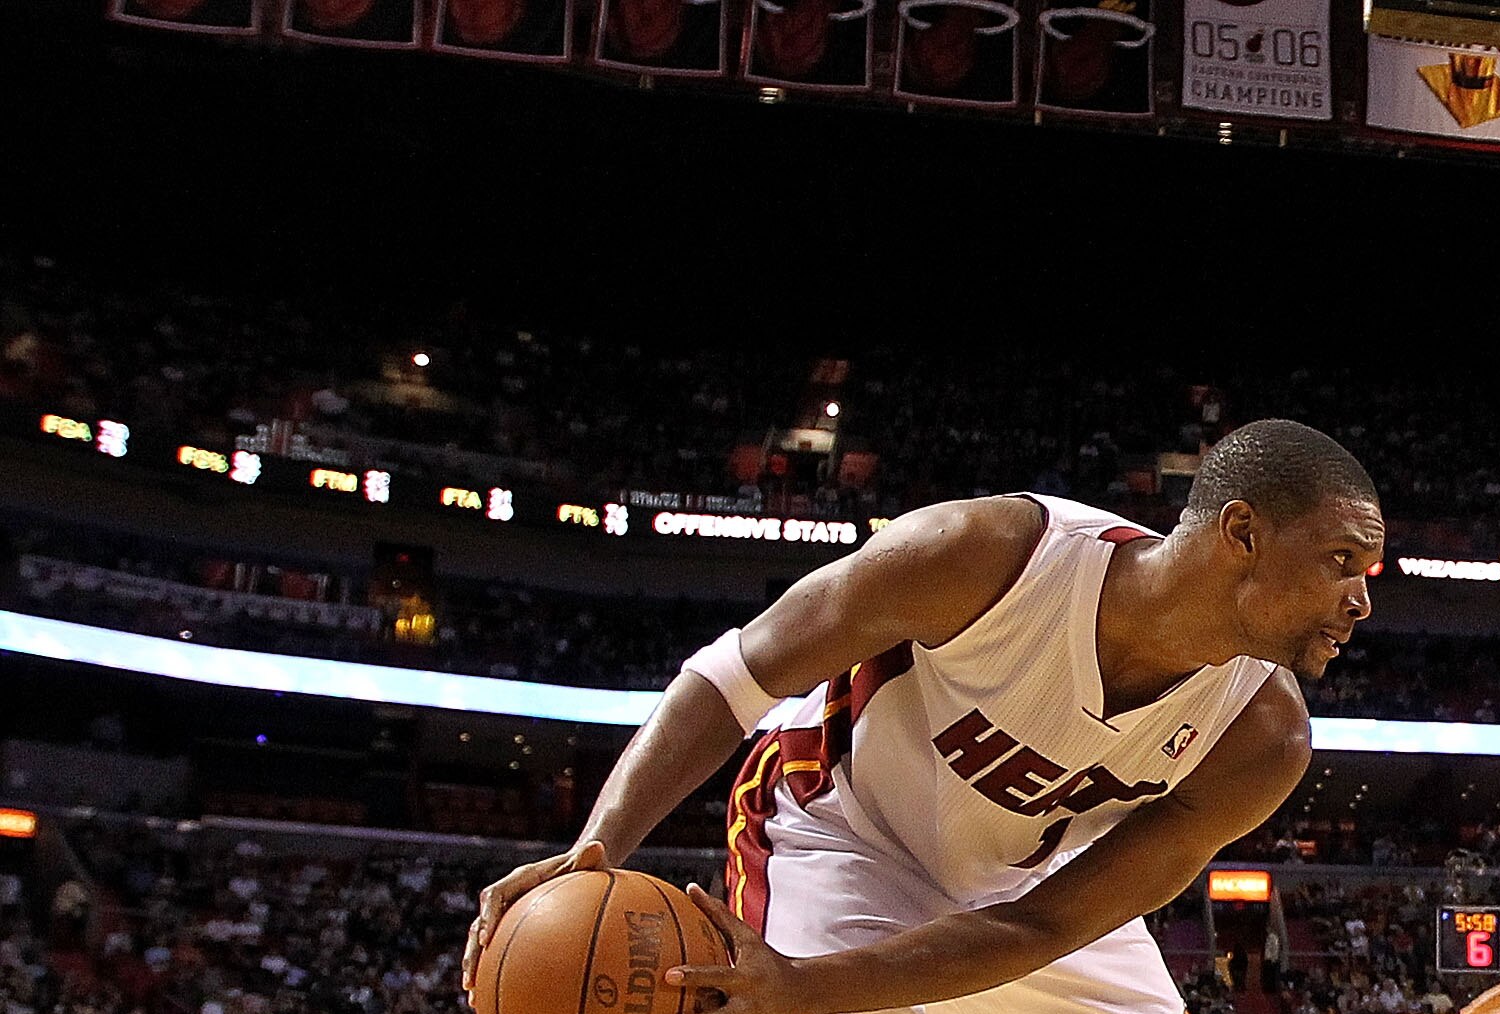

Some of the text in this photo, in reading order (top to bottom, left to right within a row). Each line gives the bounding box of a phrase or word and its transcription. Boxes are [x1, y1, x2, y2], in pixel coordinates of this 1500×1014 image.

[1191, 20, 1240, 61] 05
[1272, 28, 1322, 68] 06
[1191, 78, 1323, 108] CHAMPIONS
[440, 487, 482, 510] FTA
[651, 511, 857, 544] OFFENSIVE STATS
[931, 706, 1168, 817] HEAT
[1454, 912, 1498, 934] 5:58
[1466, 930, 1493, 968] 6
